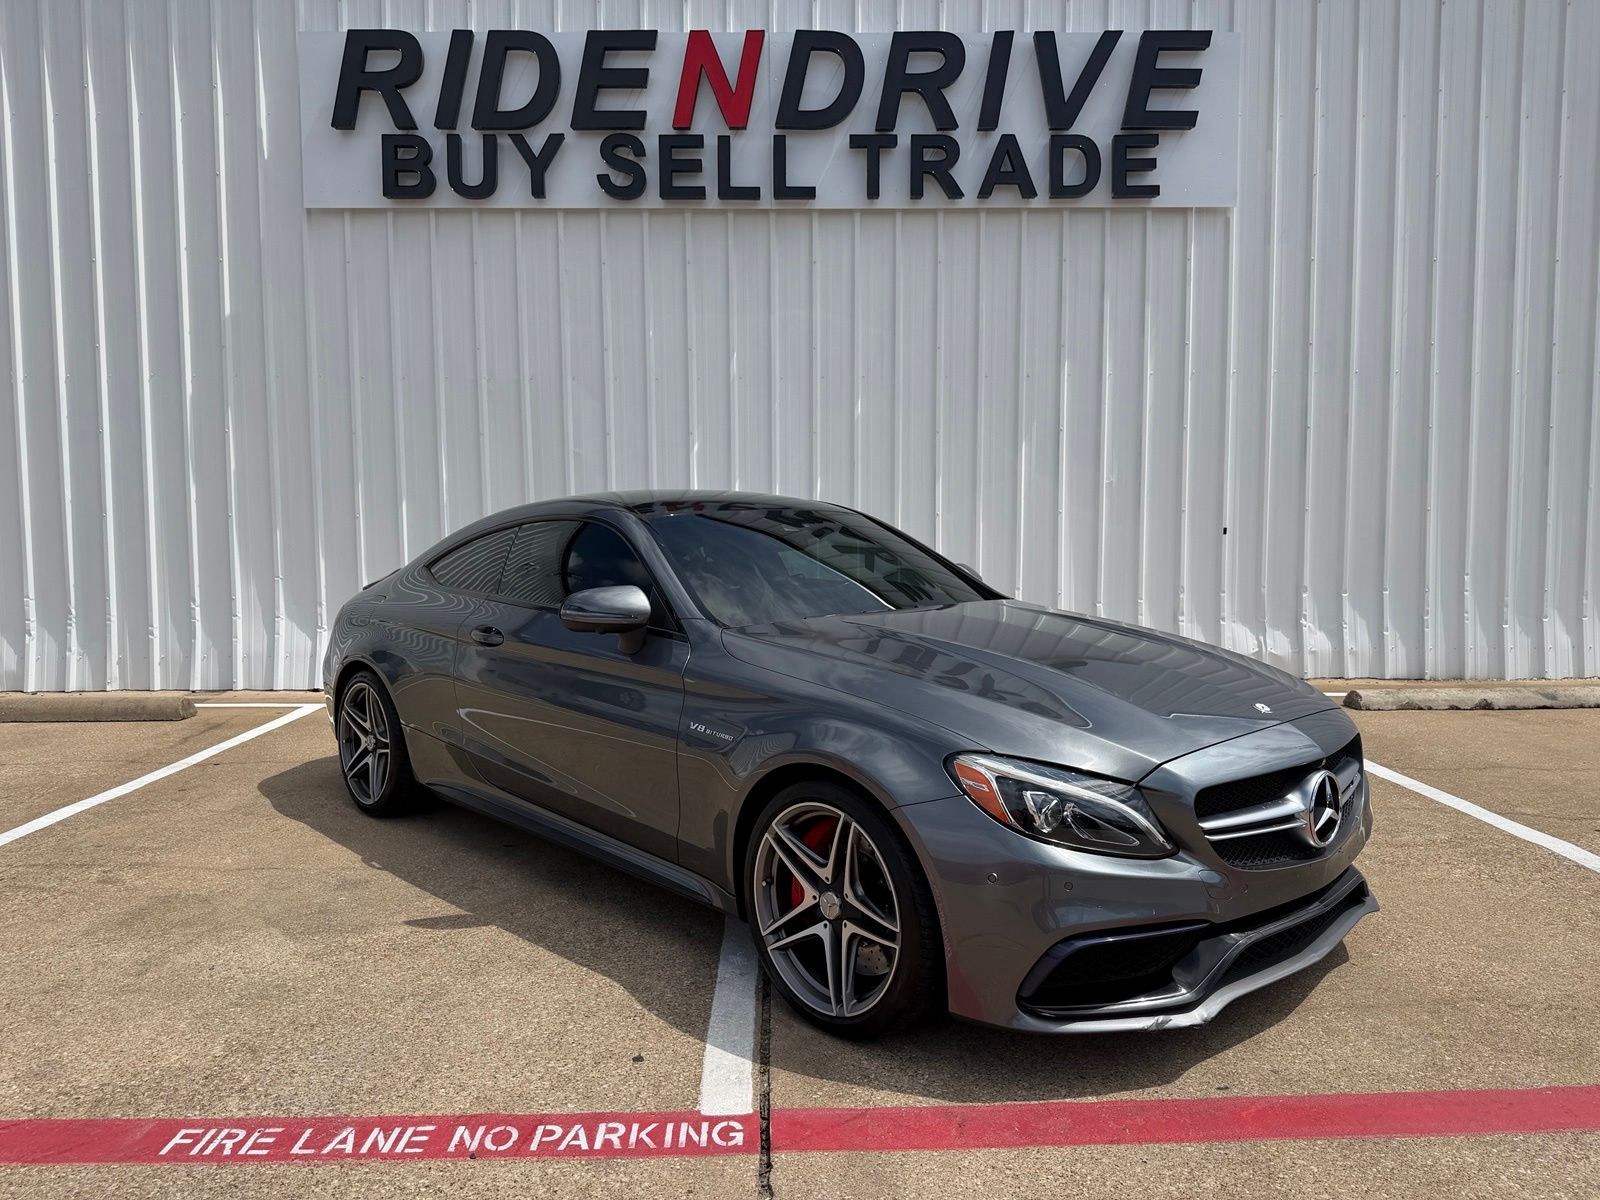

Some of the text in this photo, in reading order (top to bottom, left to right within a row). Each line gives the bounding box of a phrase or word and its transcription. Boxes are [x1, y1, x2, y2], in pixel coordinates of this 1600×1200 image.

[331, 29, 1213, 131] RIDENDRIVE
[381, 133, 1161, 200] BUY SELL TRADE
[690, 721, 705, 732] V8
[159, 1120, 745, 1156] FIRE LANE NO PARKING
